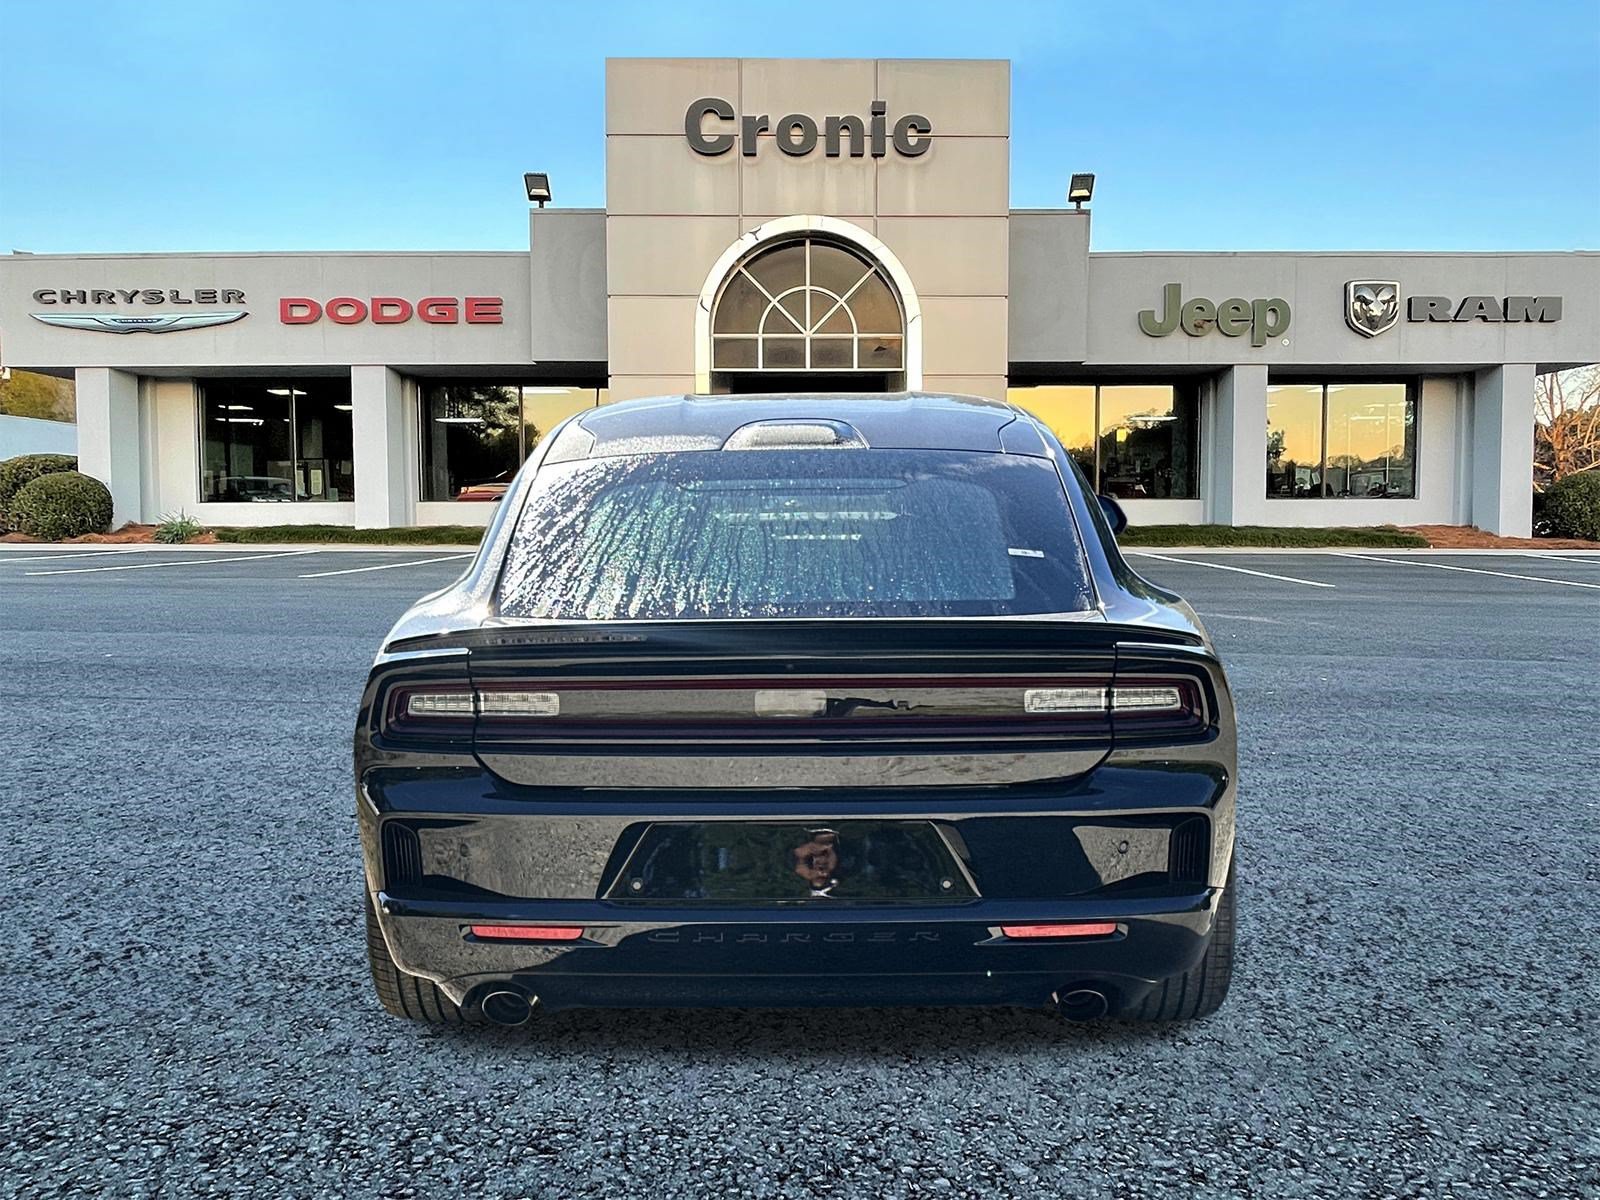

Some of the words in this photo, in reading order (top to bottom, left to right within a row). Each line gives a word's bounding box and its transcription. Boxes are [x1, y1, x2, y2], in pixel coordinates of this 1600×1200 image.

[685, 97, 932, 157] Cronic
[32, 289, 246, 305] CHRYSLER
[1407, 296, 1563, 322] RAM
[280, 297, 504, 324] DODGE
[1138, 283, 1291, 347] Jeep
[647, 931, 941, 943] CHARGER
